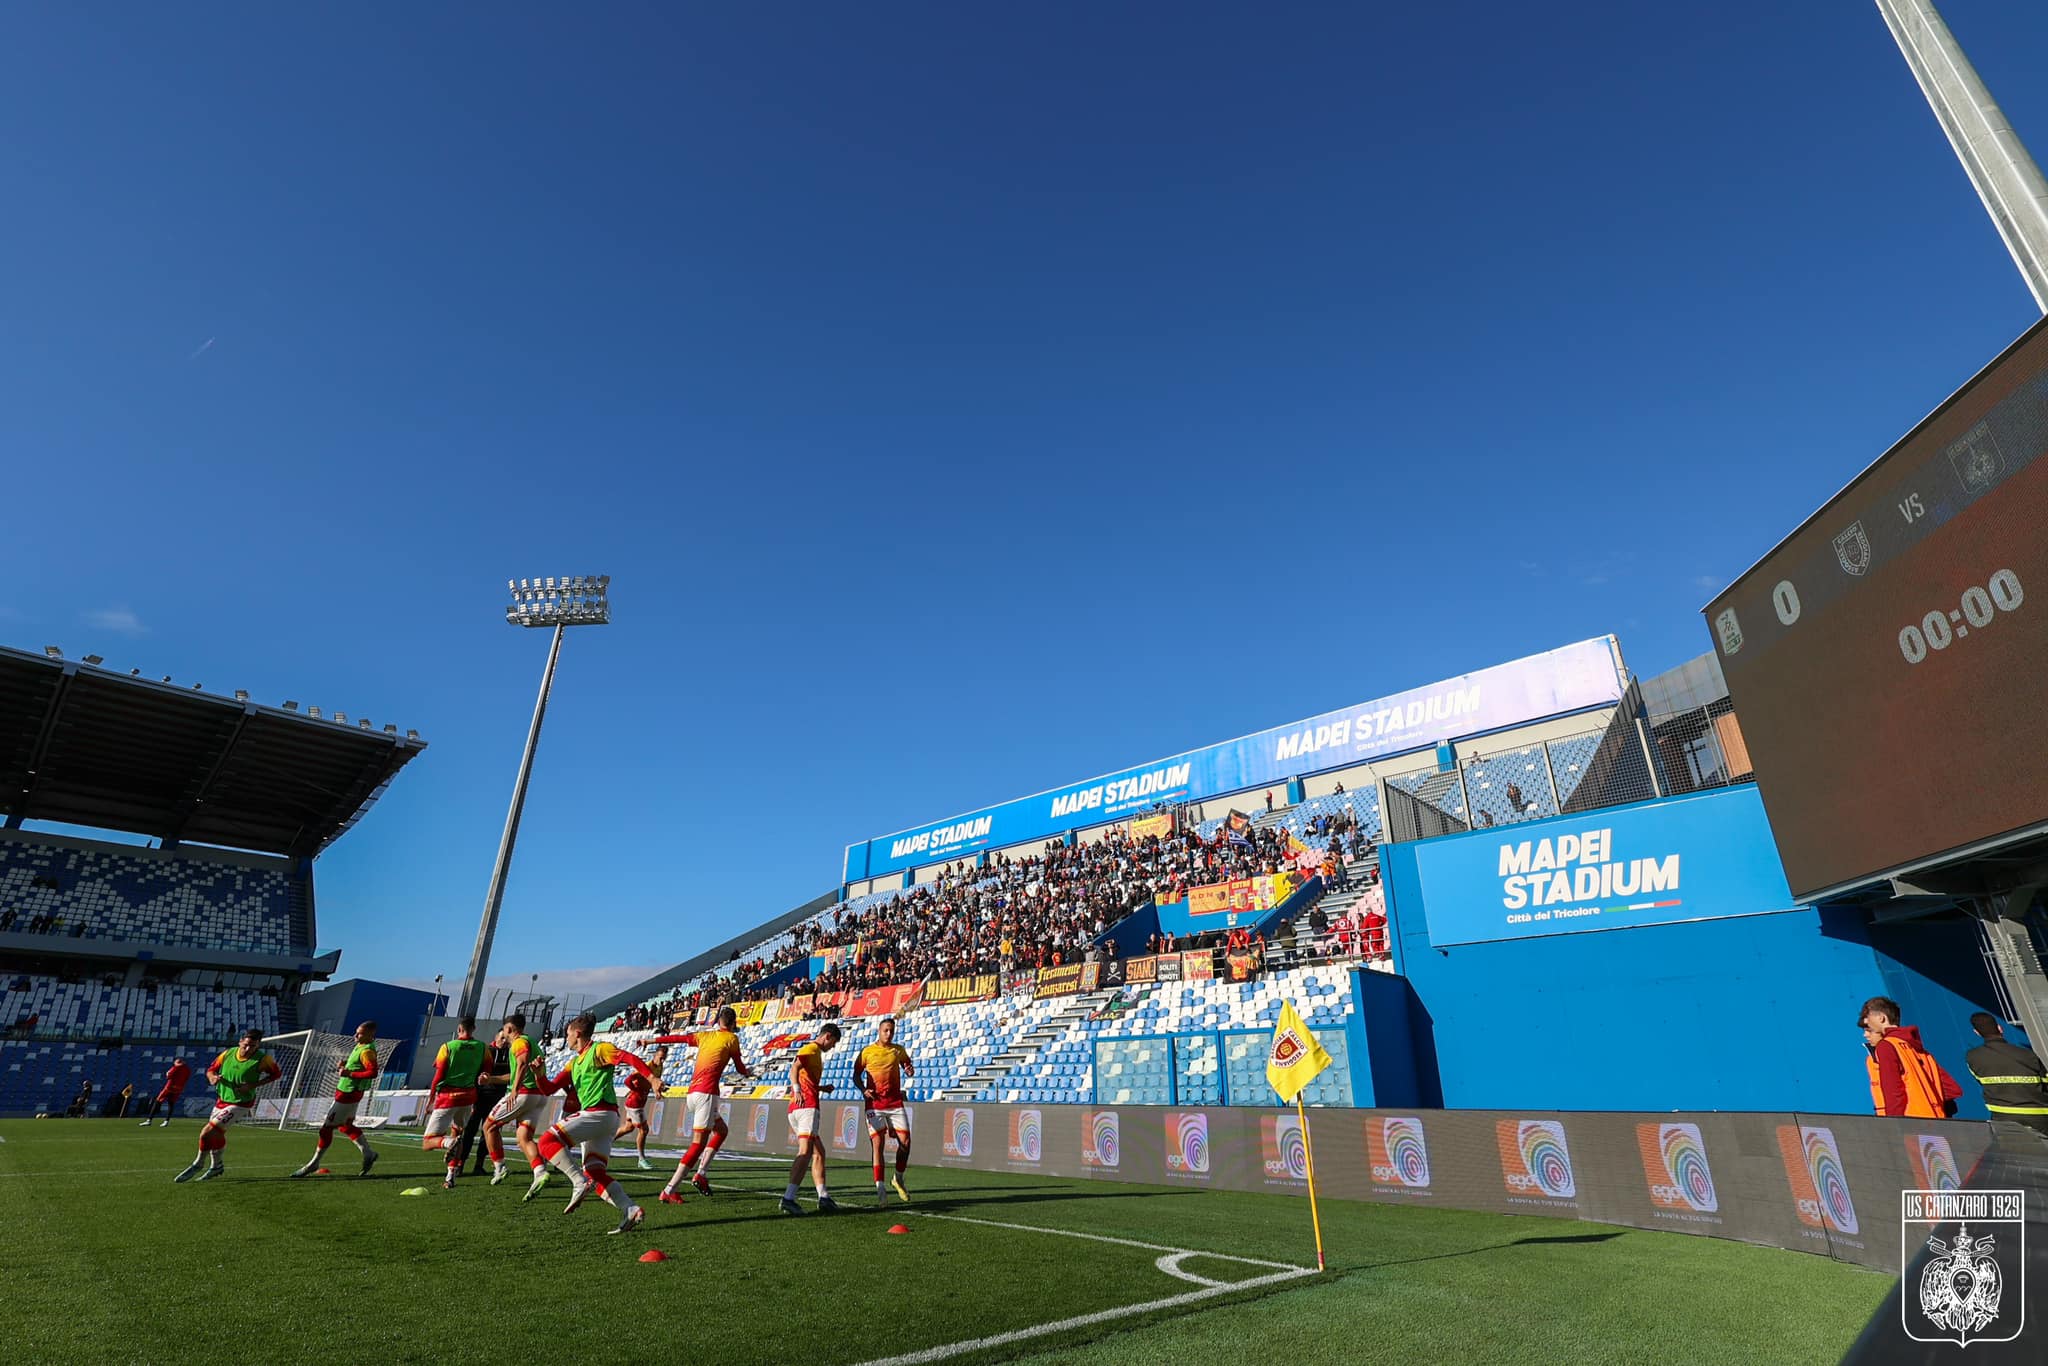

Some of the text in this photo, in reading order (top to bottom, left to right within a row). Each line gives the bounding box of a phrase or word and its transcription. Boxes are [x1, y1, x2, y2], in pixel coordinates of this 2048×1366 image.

[1898, 493, 1925, 523] VS
[1773, 580, 1800, 625] 0
[1899, 569, 2024, 663] 00:00
[1276, 685, 1480, 761] MAPEI STADIUM
[1050, 762, 1191, 818] MAPEI STADIUM
[890, 815, 993, 858] MAPEI STADIUM
[1498, 828, 1611, 876] MAPEI
[1503, 854, 1680, 909] STADIUM
[1507, 906, 1600, 924] Città del Tricolore
[1288, 1030, 1305, 1050] CALCIO
[1265, 1160, 1286, 1173] ego
[1373, 1166, 1396, 1181] ego
[1507, 1174, 1535, 1190] ego
[1652, 1185, 1682, 1204] ego
